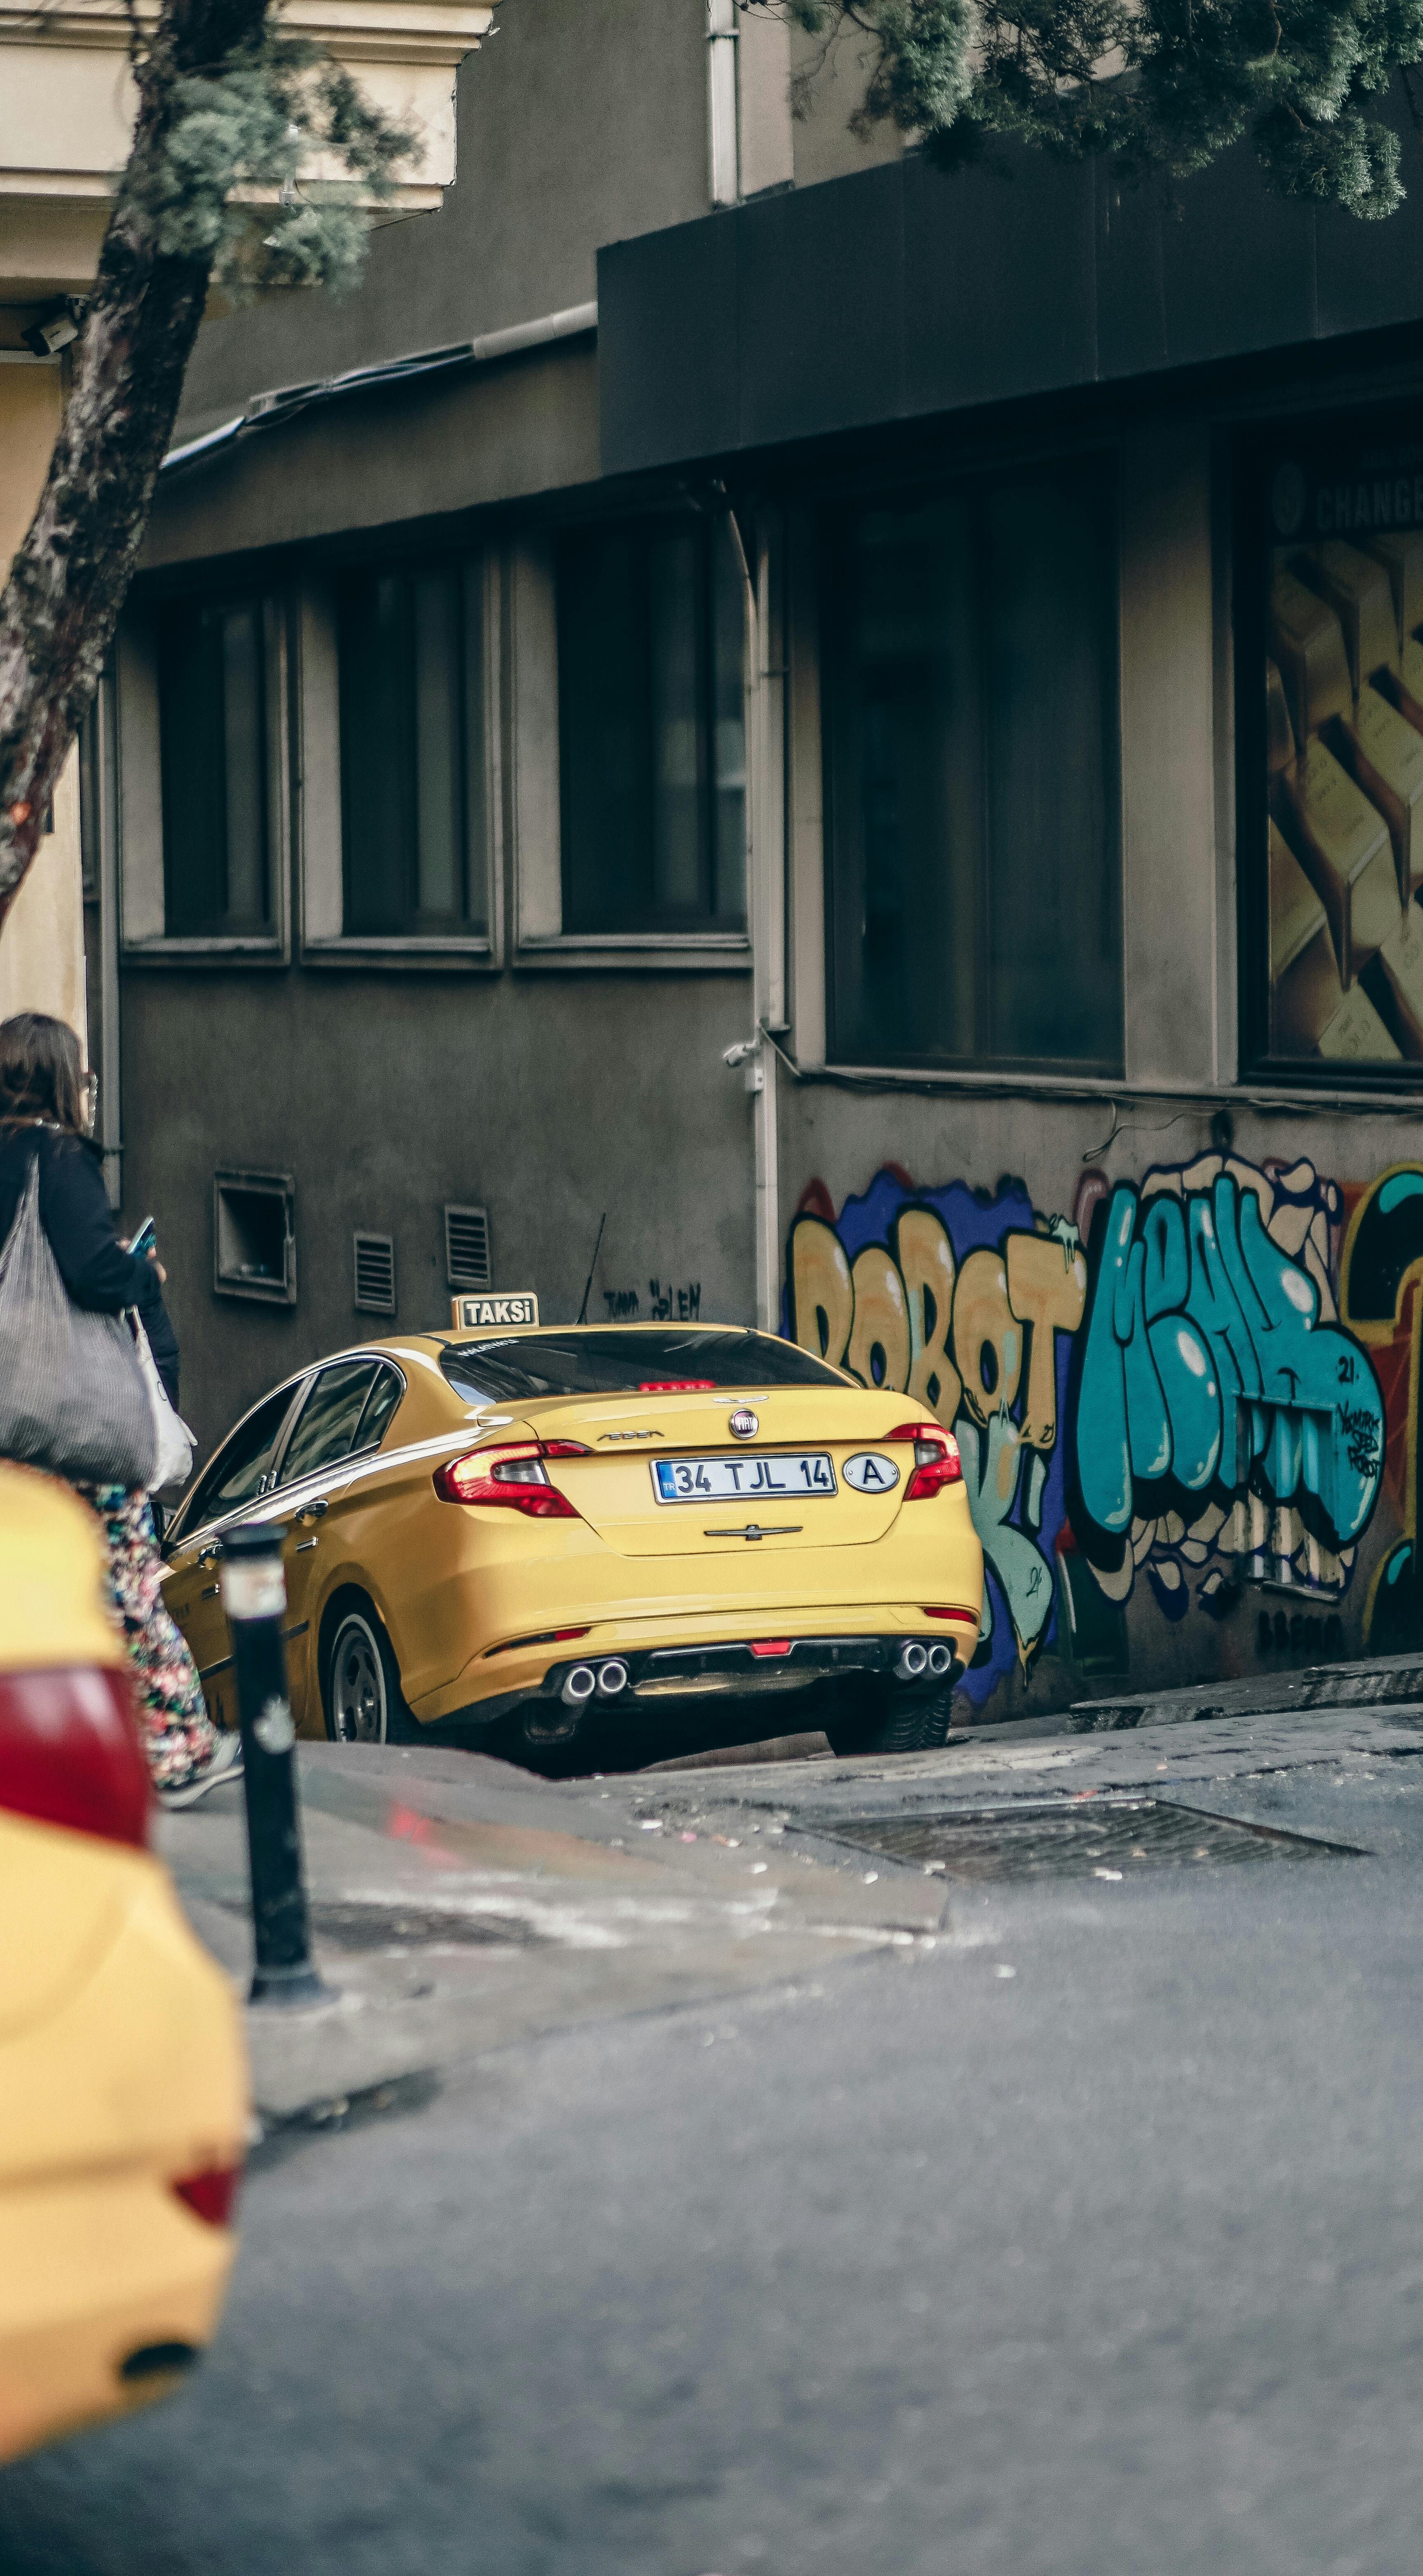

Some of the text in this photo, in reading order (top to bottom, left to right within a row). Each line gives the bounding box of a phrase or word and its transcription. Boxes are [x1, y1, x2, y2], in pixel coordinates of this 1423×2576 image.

[737, 1416, 754, 1431] FIAT
[675, 1459, 830, 1493] 34 TJL 14
[862, 1459, 885, 1485] A
[664, 1481, 676, 1491] TR
